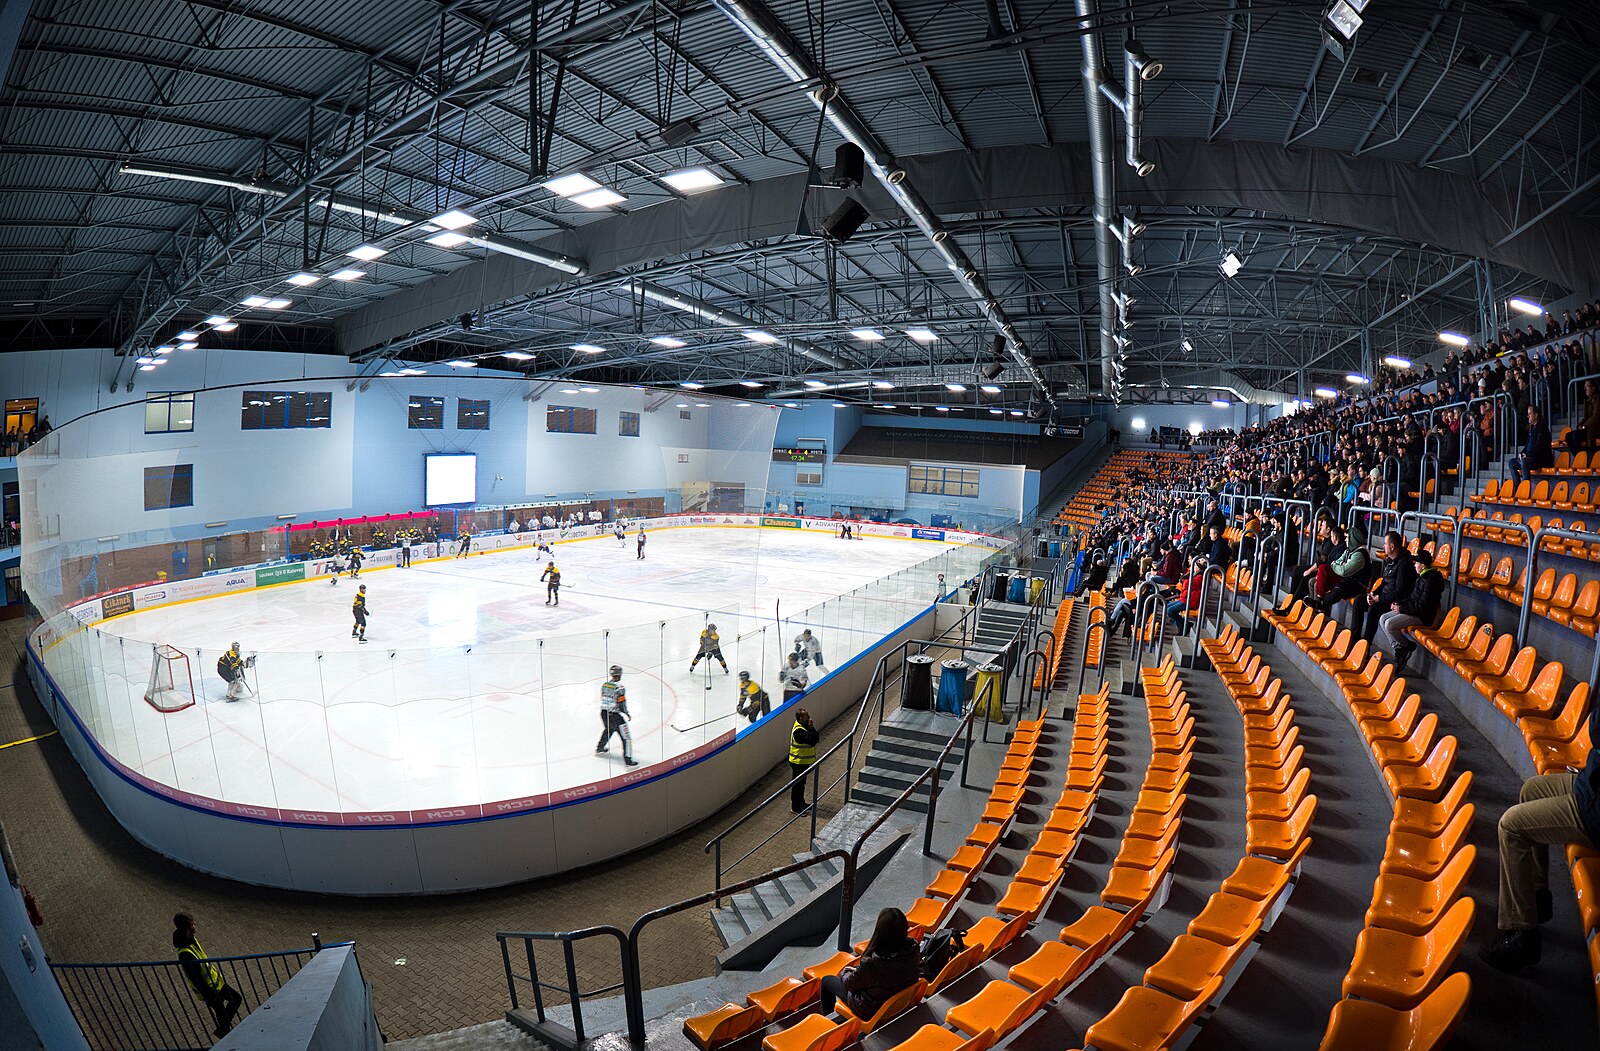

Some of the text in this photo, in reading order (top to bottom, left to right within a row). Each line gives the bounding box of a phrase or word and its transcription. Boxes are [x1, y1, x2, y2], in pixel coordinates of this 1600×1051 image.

[950, 433, 995, 441] FINANCIAL
[764, 518, 797, 527] Chance
[225, 578, 246, 587] AQUA
